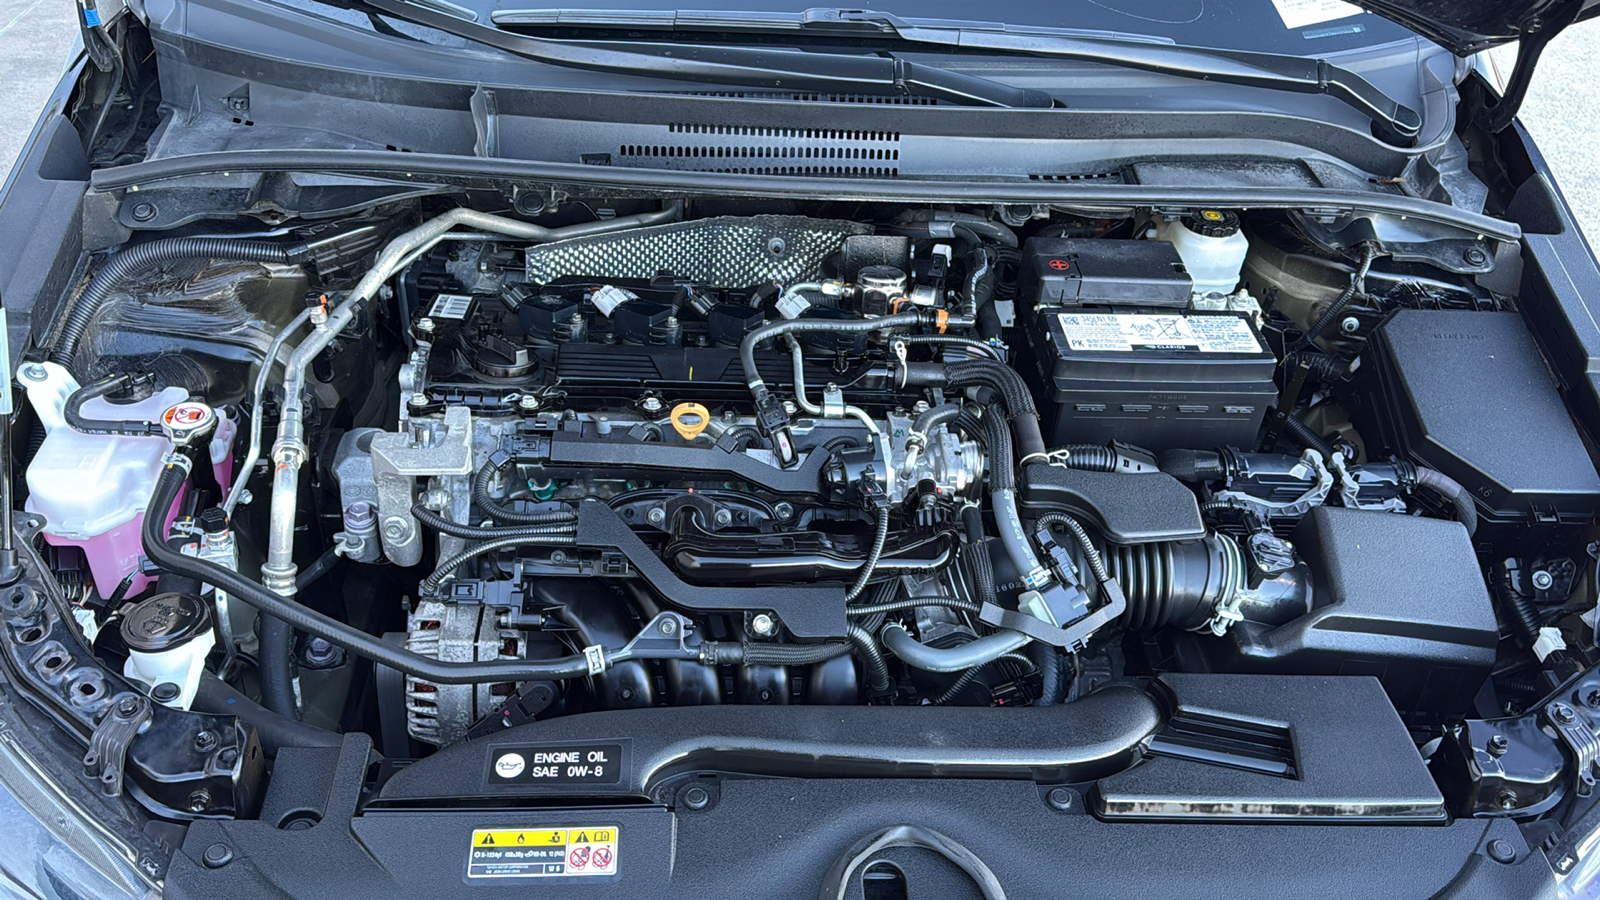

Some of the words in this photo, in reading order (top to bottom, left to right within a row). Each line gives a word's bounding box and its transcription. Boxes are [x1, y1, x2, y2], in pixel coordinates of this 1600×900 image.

[1071, 339, 1085, 347] PK
[1477, 485, 1493, 497] K6
[534, 752, 580, 764] ENGINE
[587, 751, 608, 763] OIL
[532, 766, 559, 778] SAE
[567, 765, 604, 777] 0W-8
